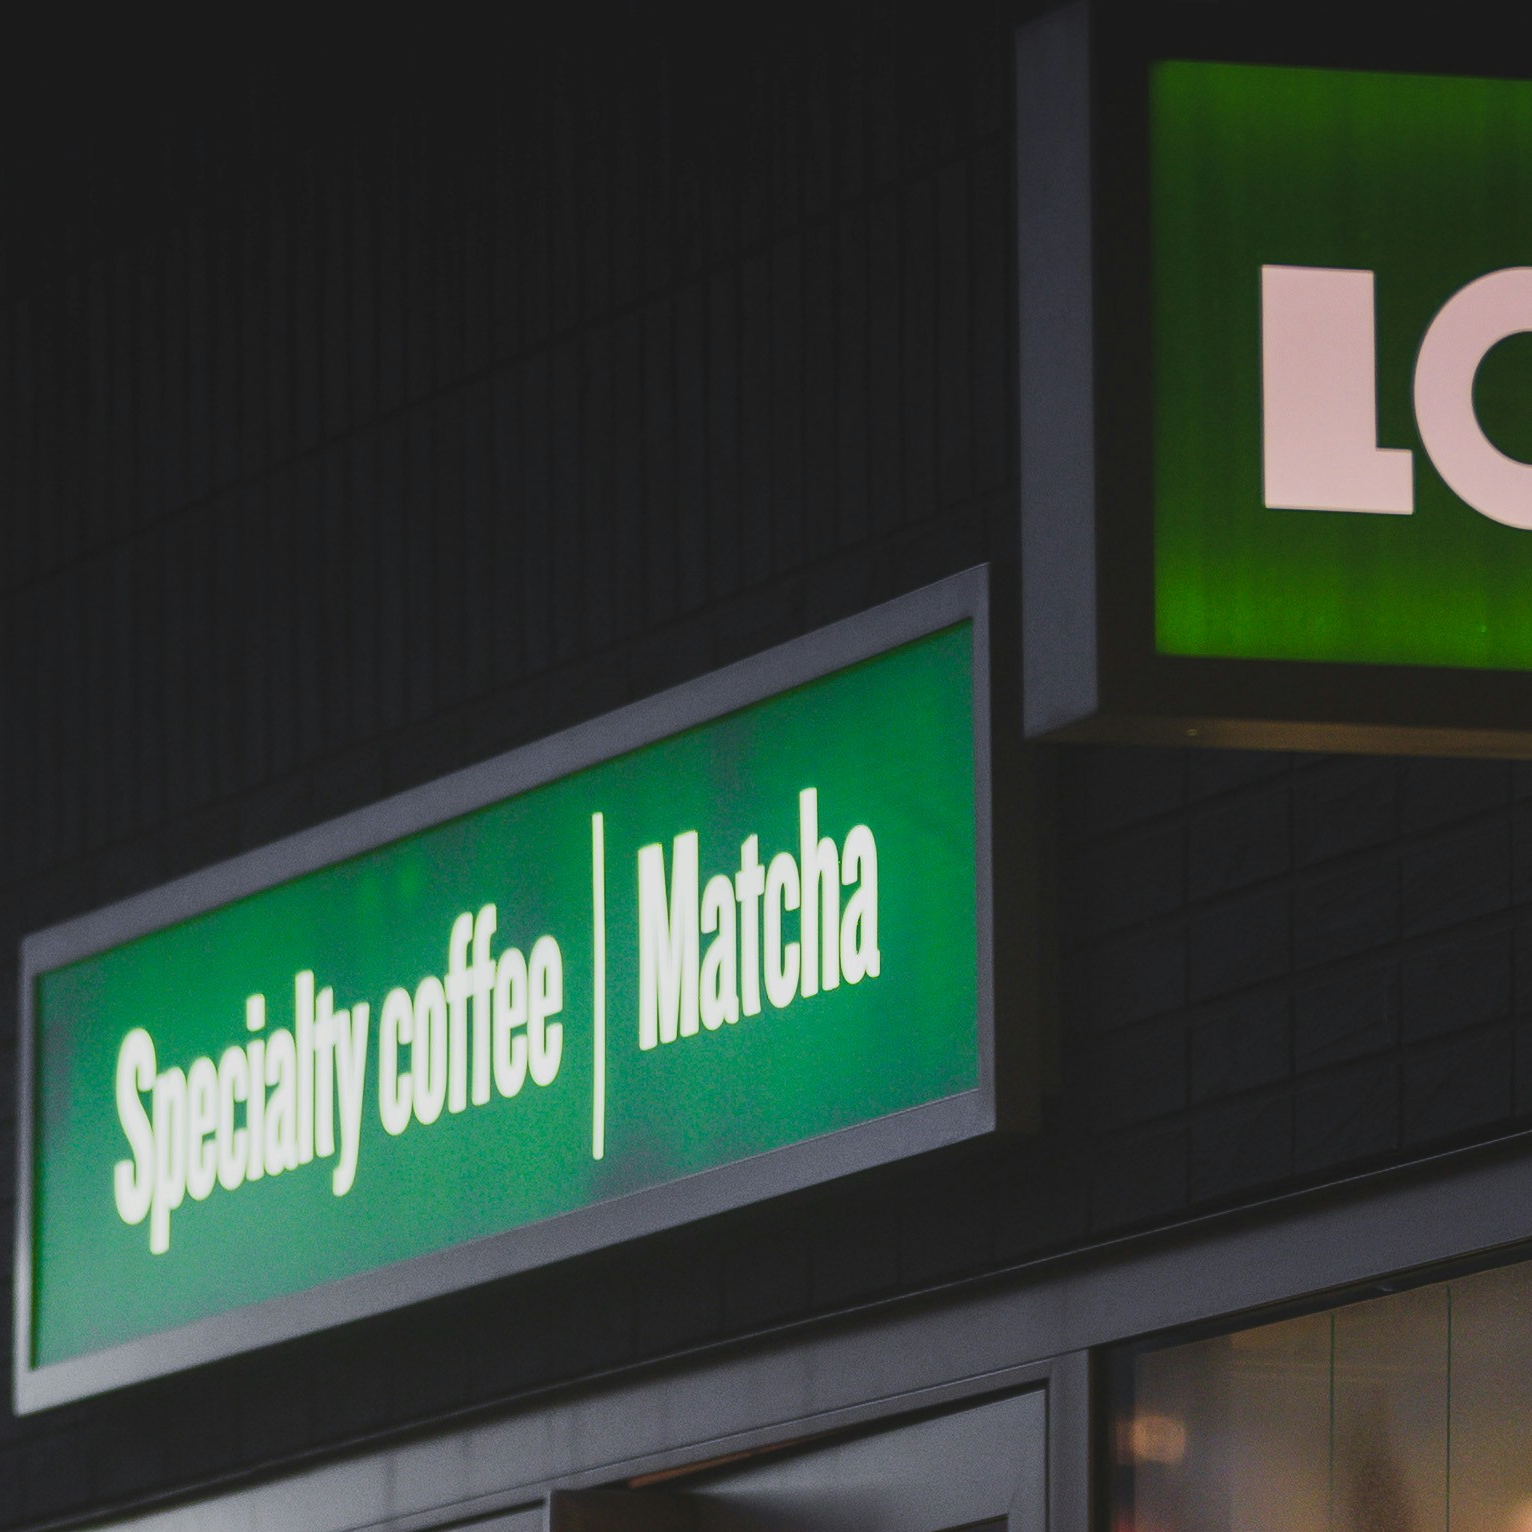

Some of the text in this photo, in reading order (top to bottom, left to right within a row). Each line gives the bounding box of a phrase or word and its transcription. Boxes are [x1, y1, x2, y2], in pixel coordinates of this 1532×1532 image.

[114, 786, 881, 1256] Specialty coffee Matcha
